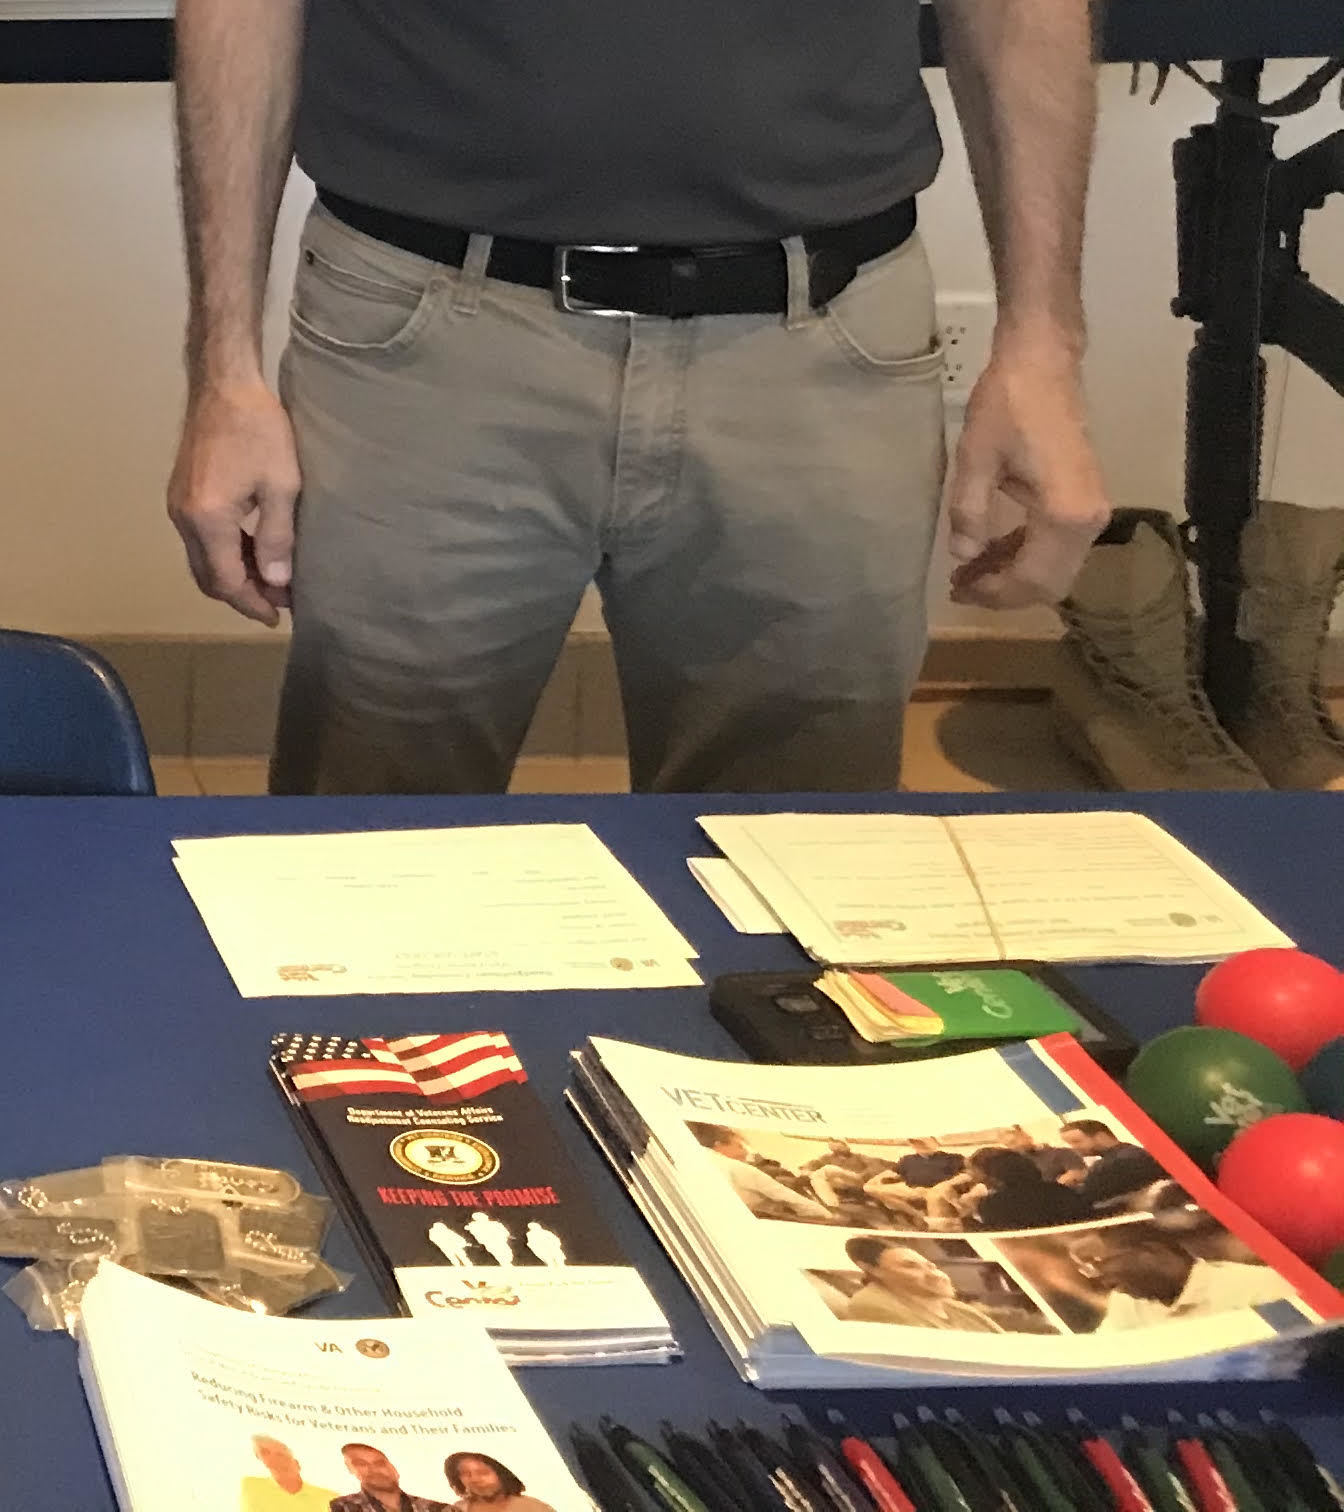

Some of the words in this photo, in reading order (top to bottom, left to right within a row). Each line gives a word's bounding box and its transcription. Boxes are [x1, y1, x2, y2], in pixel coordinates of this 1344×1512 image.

[377, 1185, 449, 1207] KEEPING
[449, 1190, 479, 1206] THE
[481, 1185, 560, 1207] PROMISE
[314, 1340, 343, 1354] VA
[191, 1371, 258, 1402] Reducing
[259, 1391, 317, 1413] Firearm
[335, 1402, 378, 1418] Other
[382, 1405, 463, 1419] Household
[198, 1388, 244, 1414] Safety
[246, 1402, 283, 1425] Risks
[285, 1412, 307, 1426] for
[310, 1418, 377, 1435] Veterans
[380, 1422, 407, 1435] and
[411, 1421, 448, 1435] Their
[452, 1422, 517, 1435] Families
